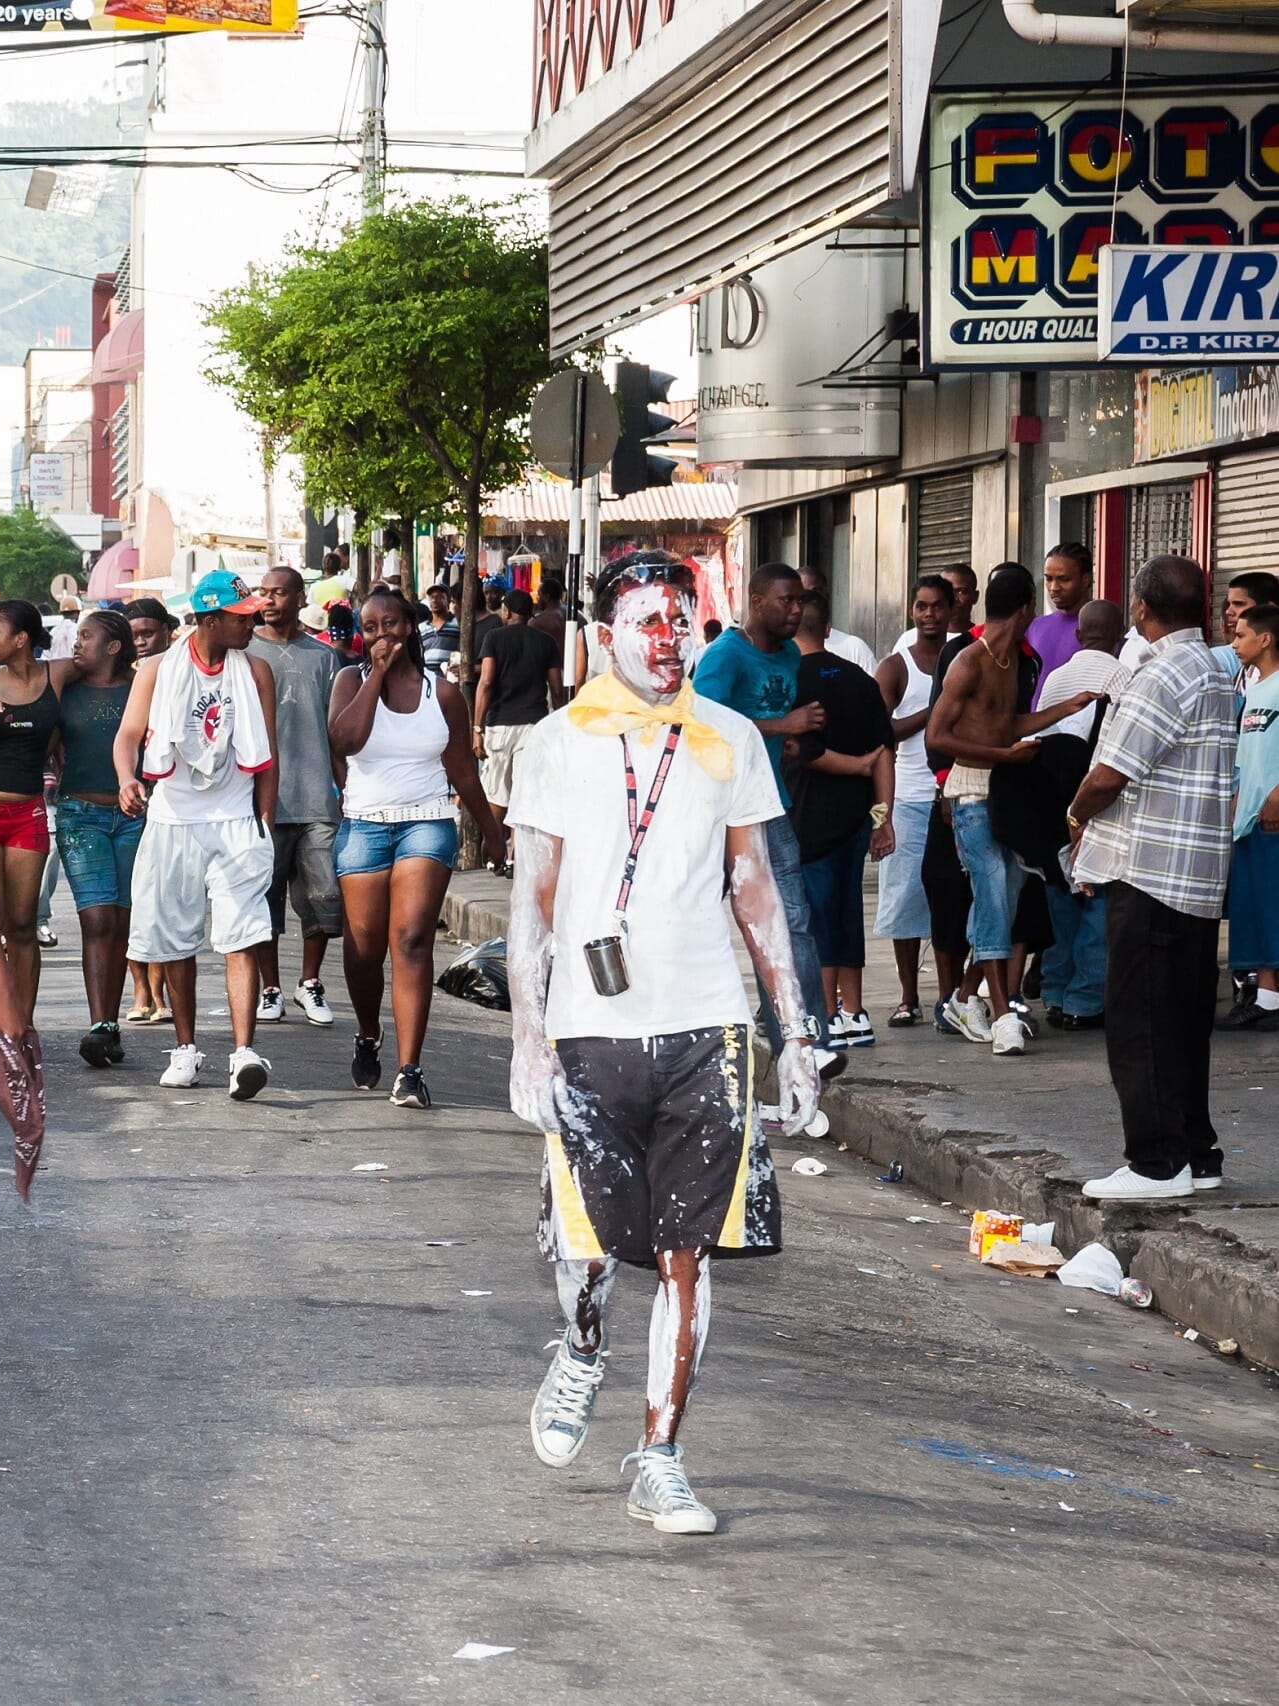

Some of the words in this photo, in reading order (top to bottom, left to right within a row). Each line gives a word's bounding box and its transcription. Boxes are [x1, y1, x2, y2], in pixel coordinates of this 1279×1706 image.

[21, 7, 74, 25] years
[973, 120, 1279, 184] FOT
[1111, 252, 1279, 322] KIR
[962, 323, 972, 341] 1
[978, 320, 1040, 341] HOUR
[1042, 318, 1097, 341] QUAL
[1140, 335, 1187, 350] D.P.
